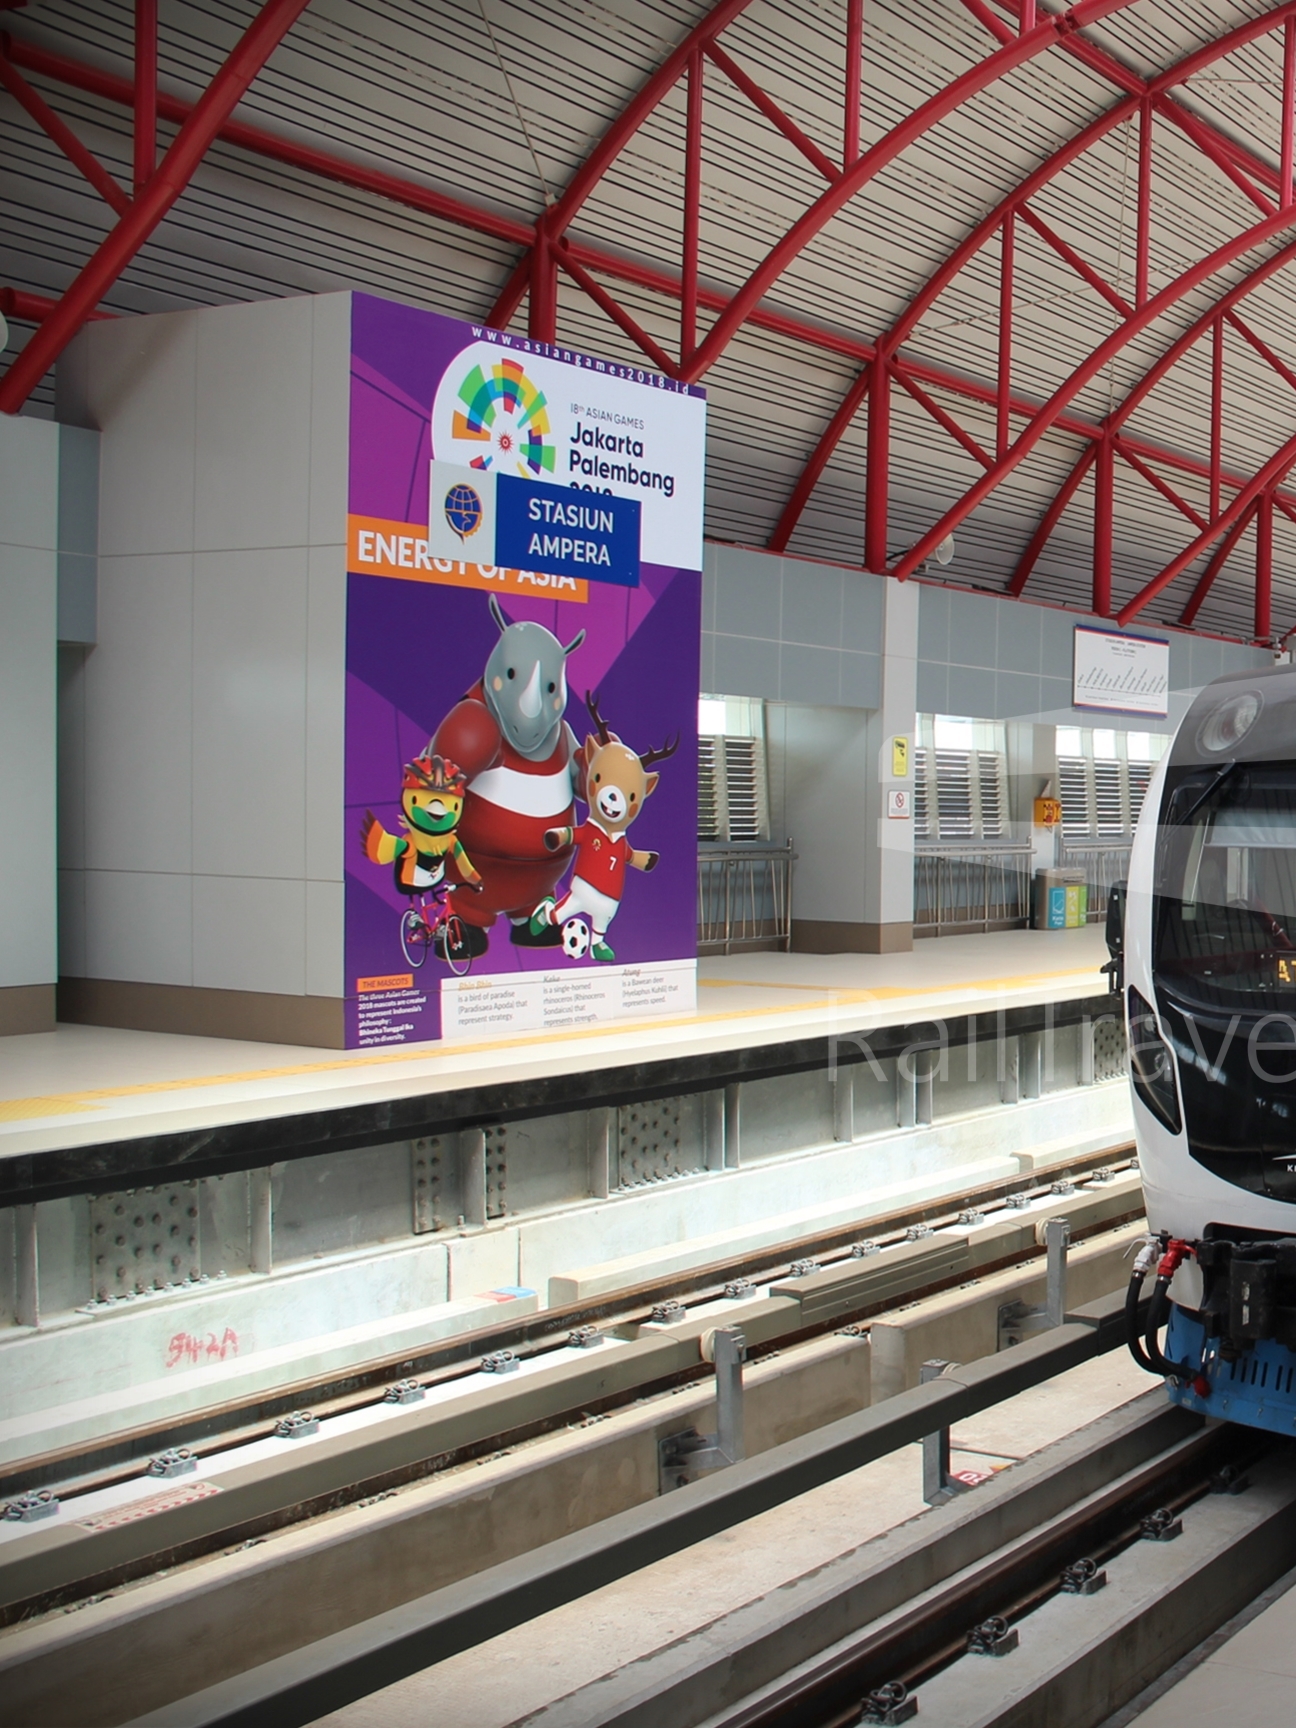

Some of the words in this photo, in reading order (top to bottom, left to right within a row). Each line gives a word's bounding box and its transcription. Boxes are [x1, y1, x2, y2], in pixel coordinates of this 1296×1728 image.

[471, 326, 689, 395] www.asiangames2018.id
[586, 407, 613, 422] ASIAN
[613, 414, 645, 430] GAMES
[569, 421, 644, 458] Jakarta
[569, 449, 675, 498] Palembang
[528, 497, 614, 534] STASIUN
[528, 533, 611, 567] AMPERA
[609, 855, 617, 871] 7
[378, 978, 408, 987] MASCOTS
[358, 1002, 373, 1010] 2018
[406, 996, 427, 1004] created
[469, 994, 481, 1002] bird
[483, 992, 489, 1000] of
[490, 990, 515, 1000] paradise
[515, 1000, 528, 1008] that
[366, 1009, 392, 1018] represent
[458, 1016, 488, 1025] represent
[359, 1037, 374, 1045] unity
